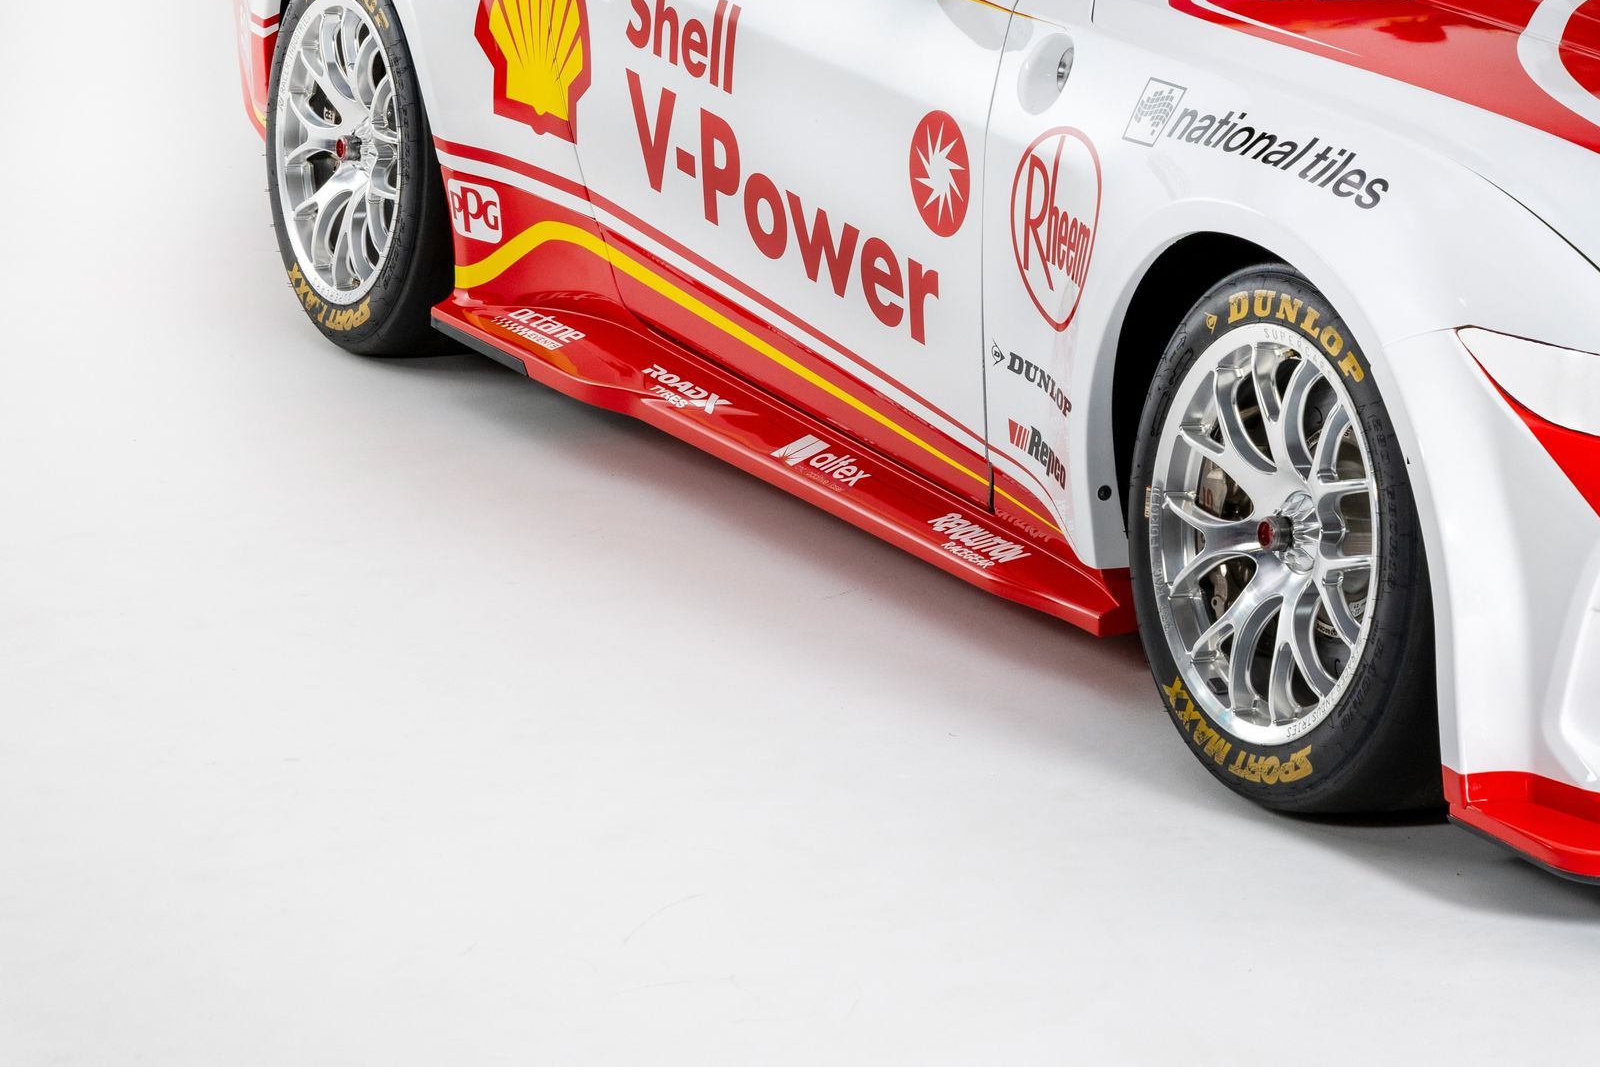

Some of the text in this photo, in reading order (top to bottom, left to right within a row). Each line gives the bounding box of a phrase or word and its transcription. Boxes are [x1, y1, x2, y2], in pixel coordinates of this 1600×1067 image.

[1167, 105, 1390, 210] national tiles
[449, 187, 499, 233] PPG
[626, 68, 939, 346] V-Power
[1023, 135, 1091, 291] Rheem
[325, 293, 371, 331] SPORT
[508, 308, 586, 344] octane
[1228, 289, 1365, 383] DUNLOP
[641, 363, 733, 415] ROADX
[649, 385, 689, 408] TYRES
[1007, 352, 1073, 418] DUNLOP
[1028, 425, 1067, 490] Repco
[928, 512, 1032, 563] REVOLUTION
[941, 541, 996, 569] RACEGEAR
[1162, 676, 1313, 785] SPORT MAXX
